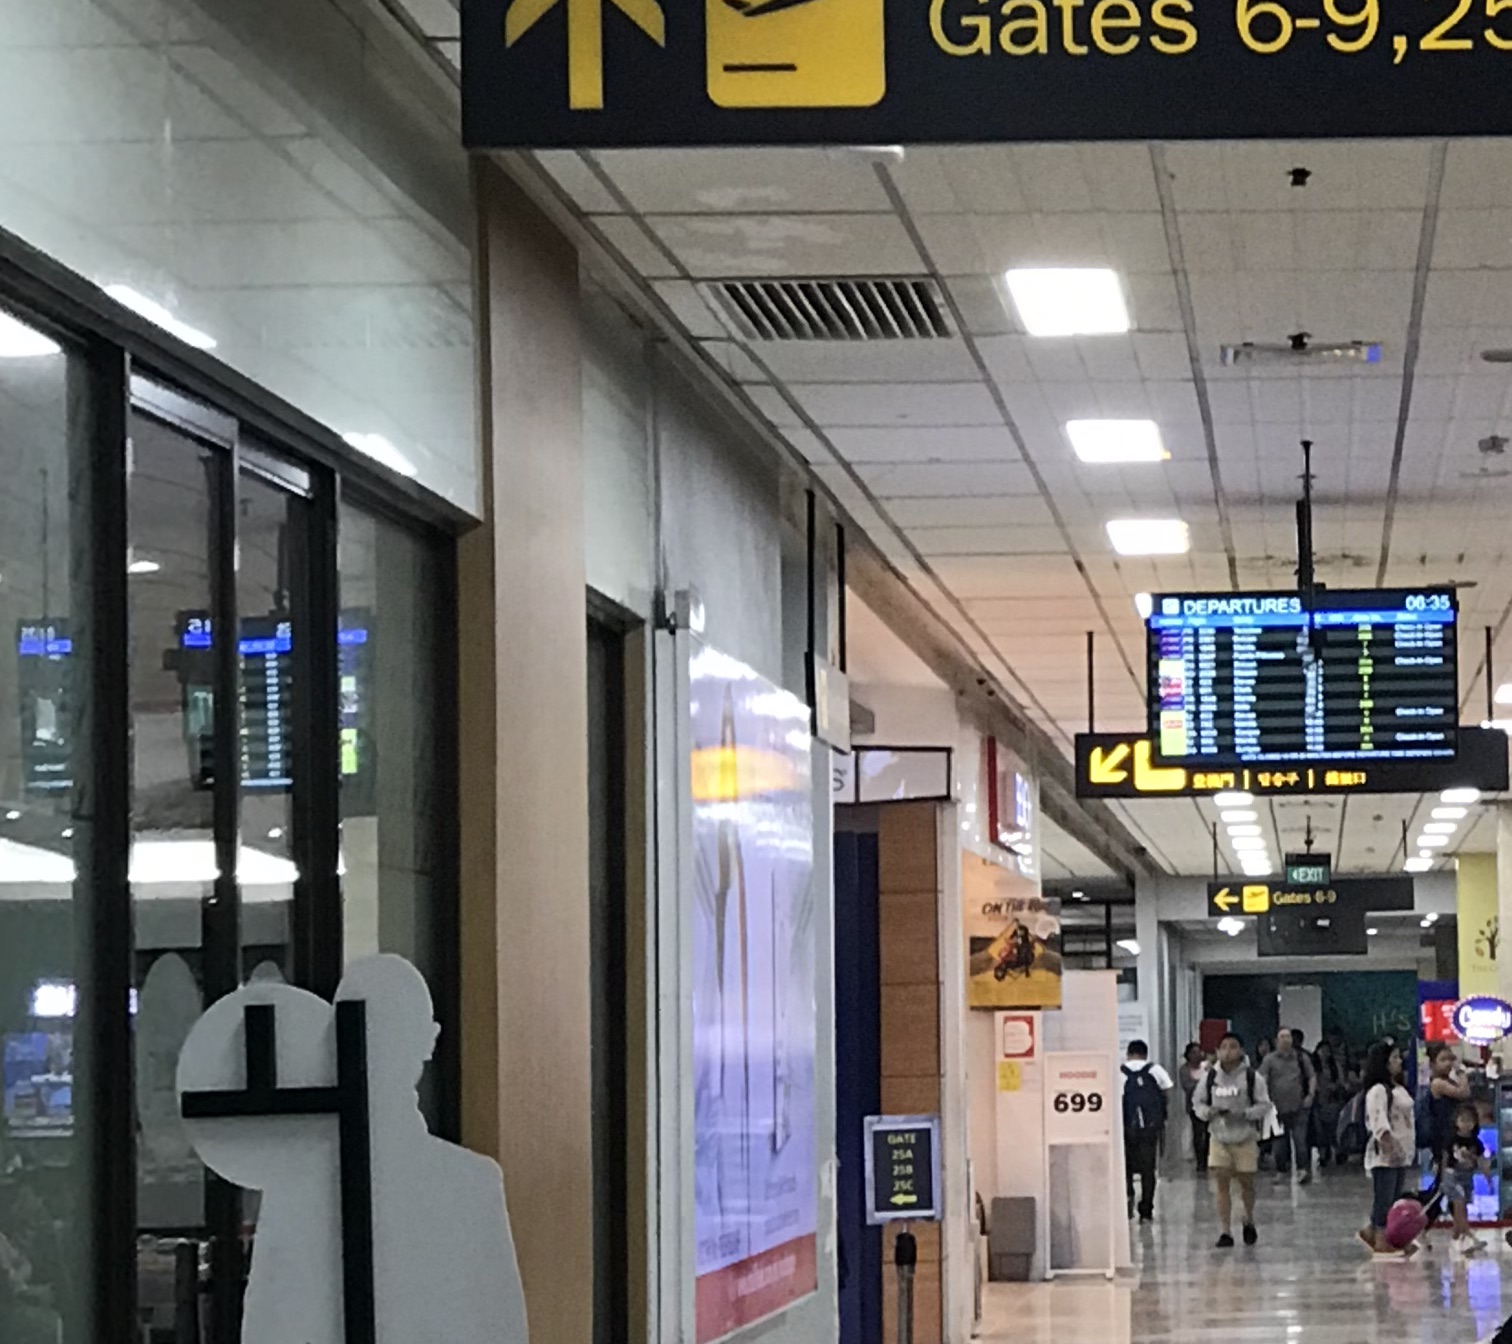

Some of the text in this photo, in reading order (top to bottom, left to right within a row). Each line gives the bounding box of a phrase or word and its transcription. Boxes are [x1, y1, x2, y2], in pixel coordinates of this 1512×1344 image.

[1183, 598, 1301, 615] DEPARTURES
[1299, 866, 1324, 883] EXIT
[1273, 891, 1312, 905] Gates
[1053, 1092, 1103, 1114] 699
[887, 1132, 917, 1145] GATE
[892, 1149, 914, 1161] 25A
